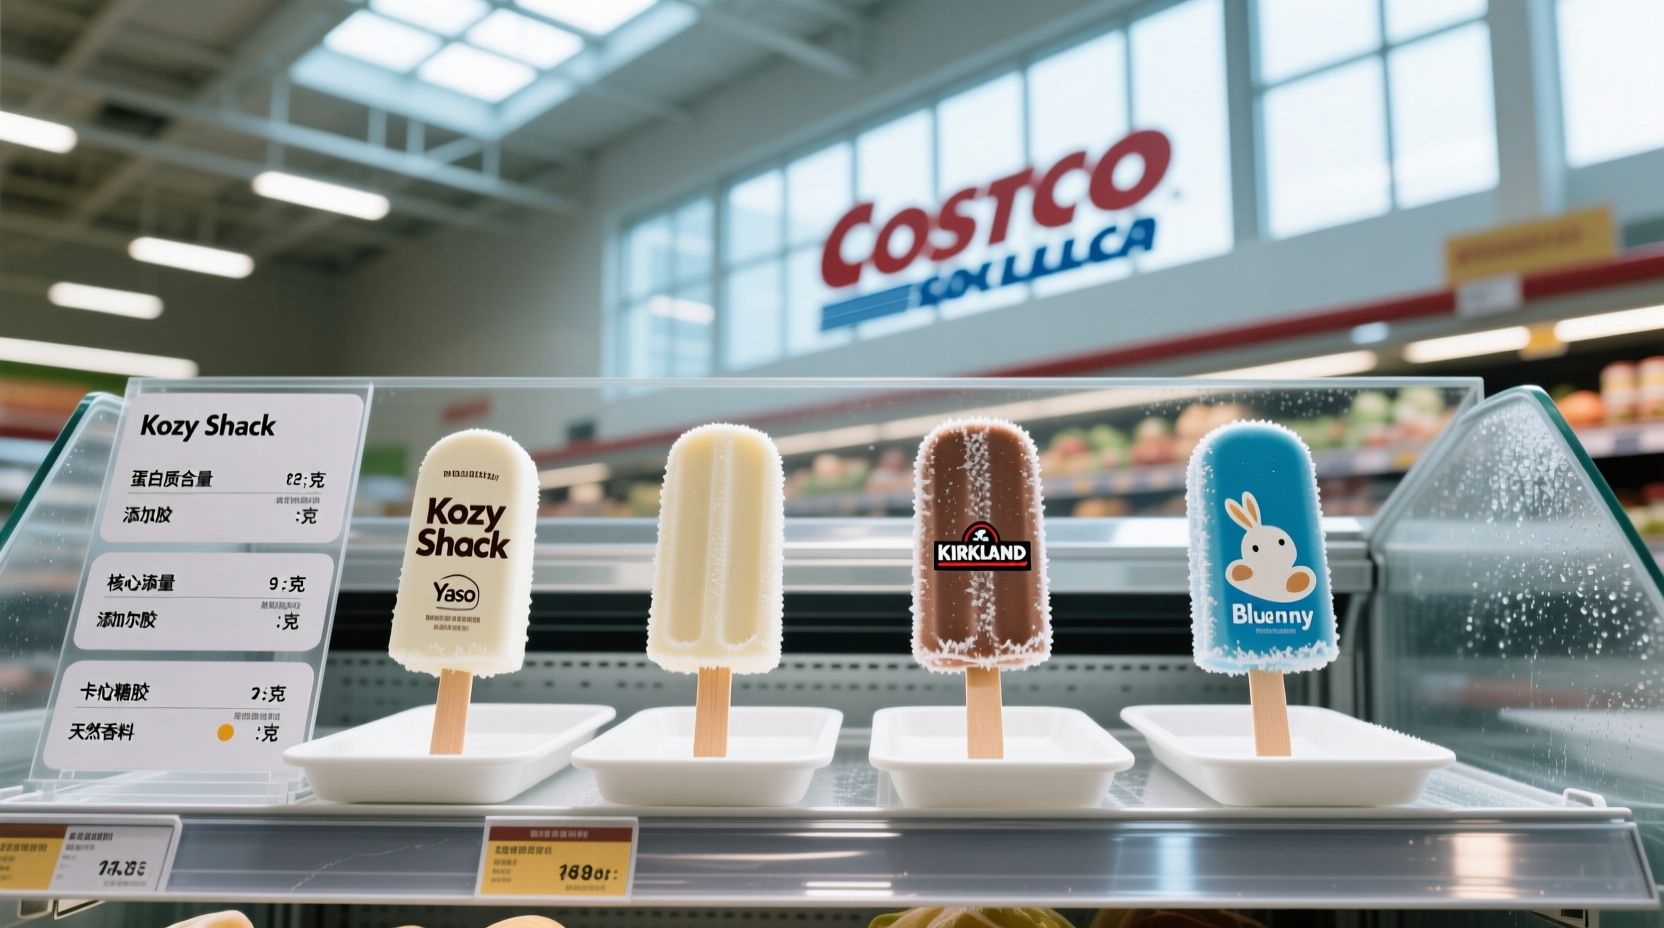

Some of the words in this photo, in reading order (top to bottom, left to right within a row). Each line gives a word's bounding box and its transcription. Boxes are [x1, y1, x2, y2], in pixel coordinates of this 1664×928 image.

[821, 129, 1172, 288] COSTCO
[140, 414, 199, 442] Kozy
[205, 413, 277, 436] Shack
[427, 497, 507, 533] Kozy
[416, 527, 511, 559] Shack
[937, 544, 1027, 561] KIRKLAND
[433, 581, 476, 603] Yaso
[1232, 603, 1314, 631] Bluenny
